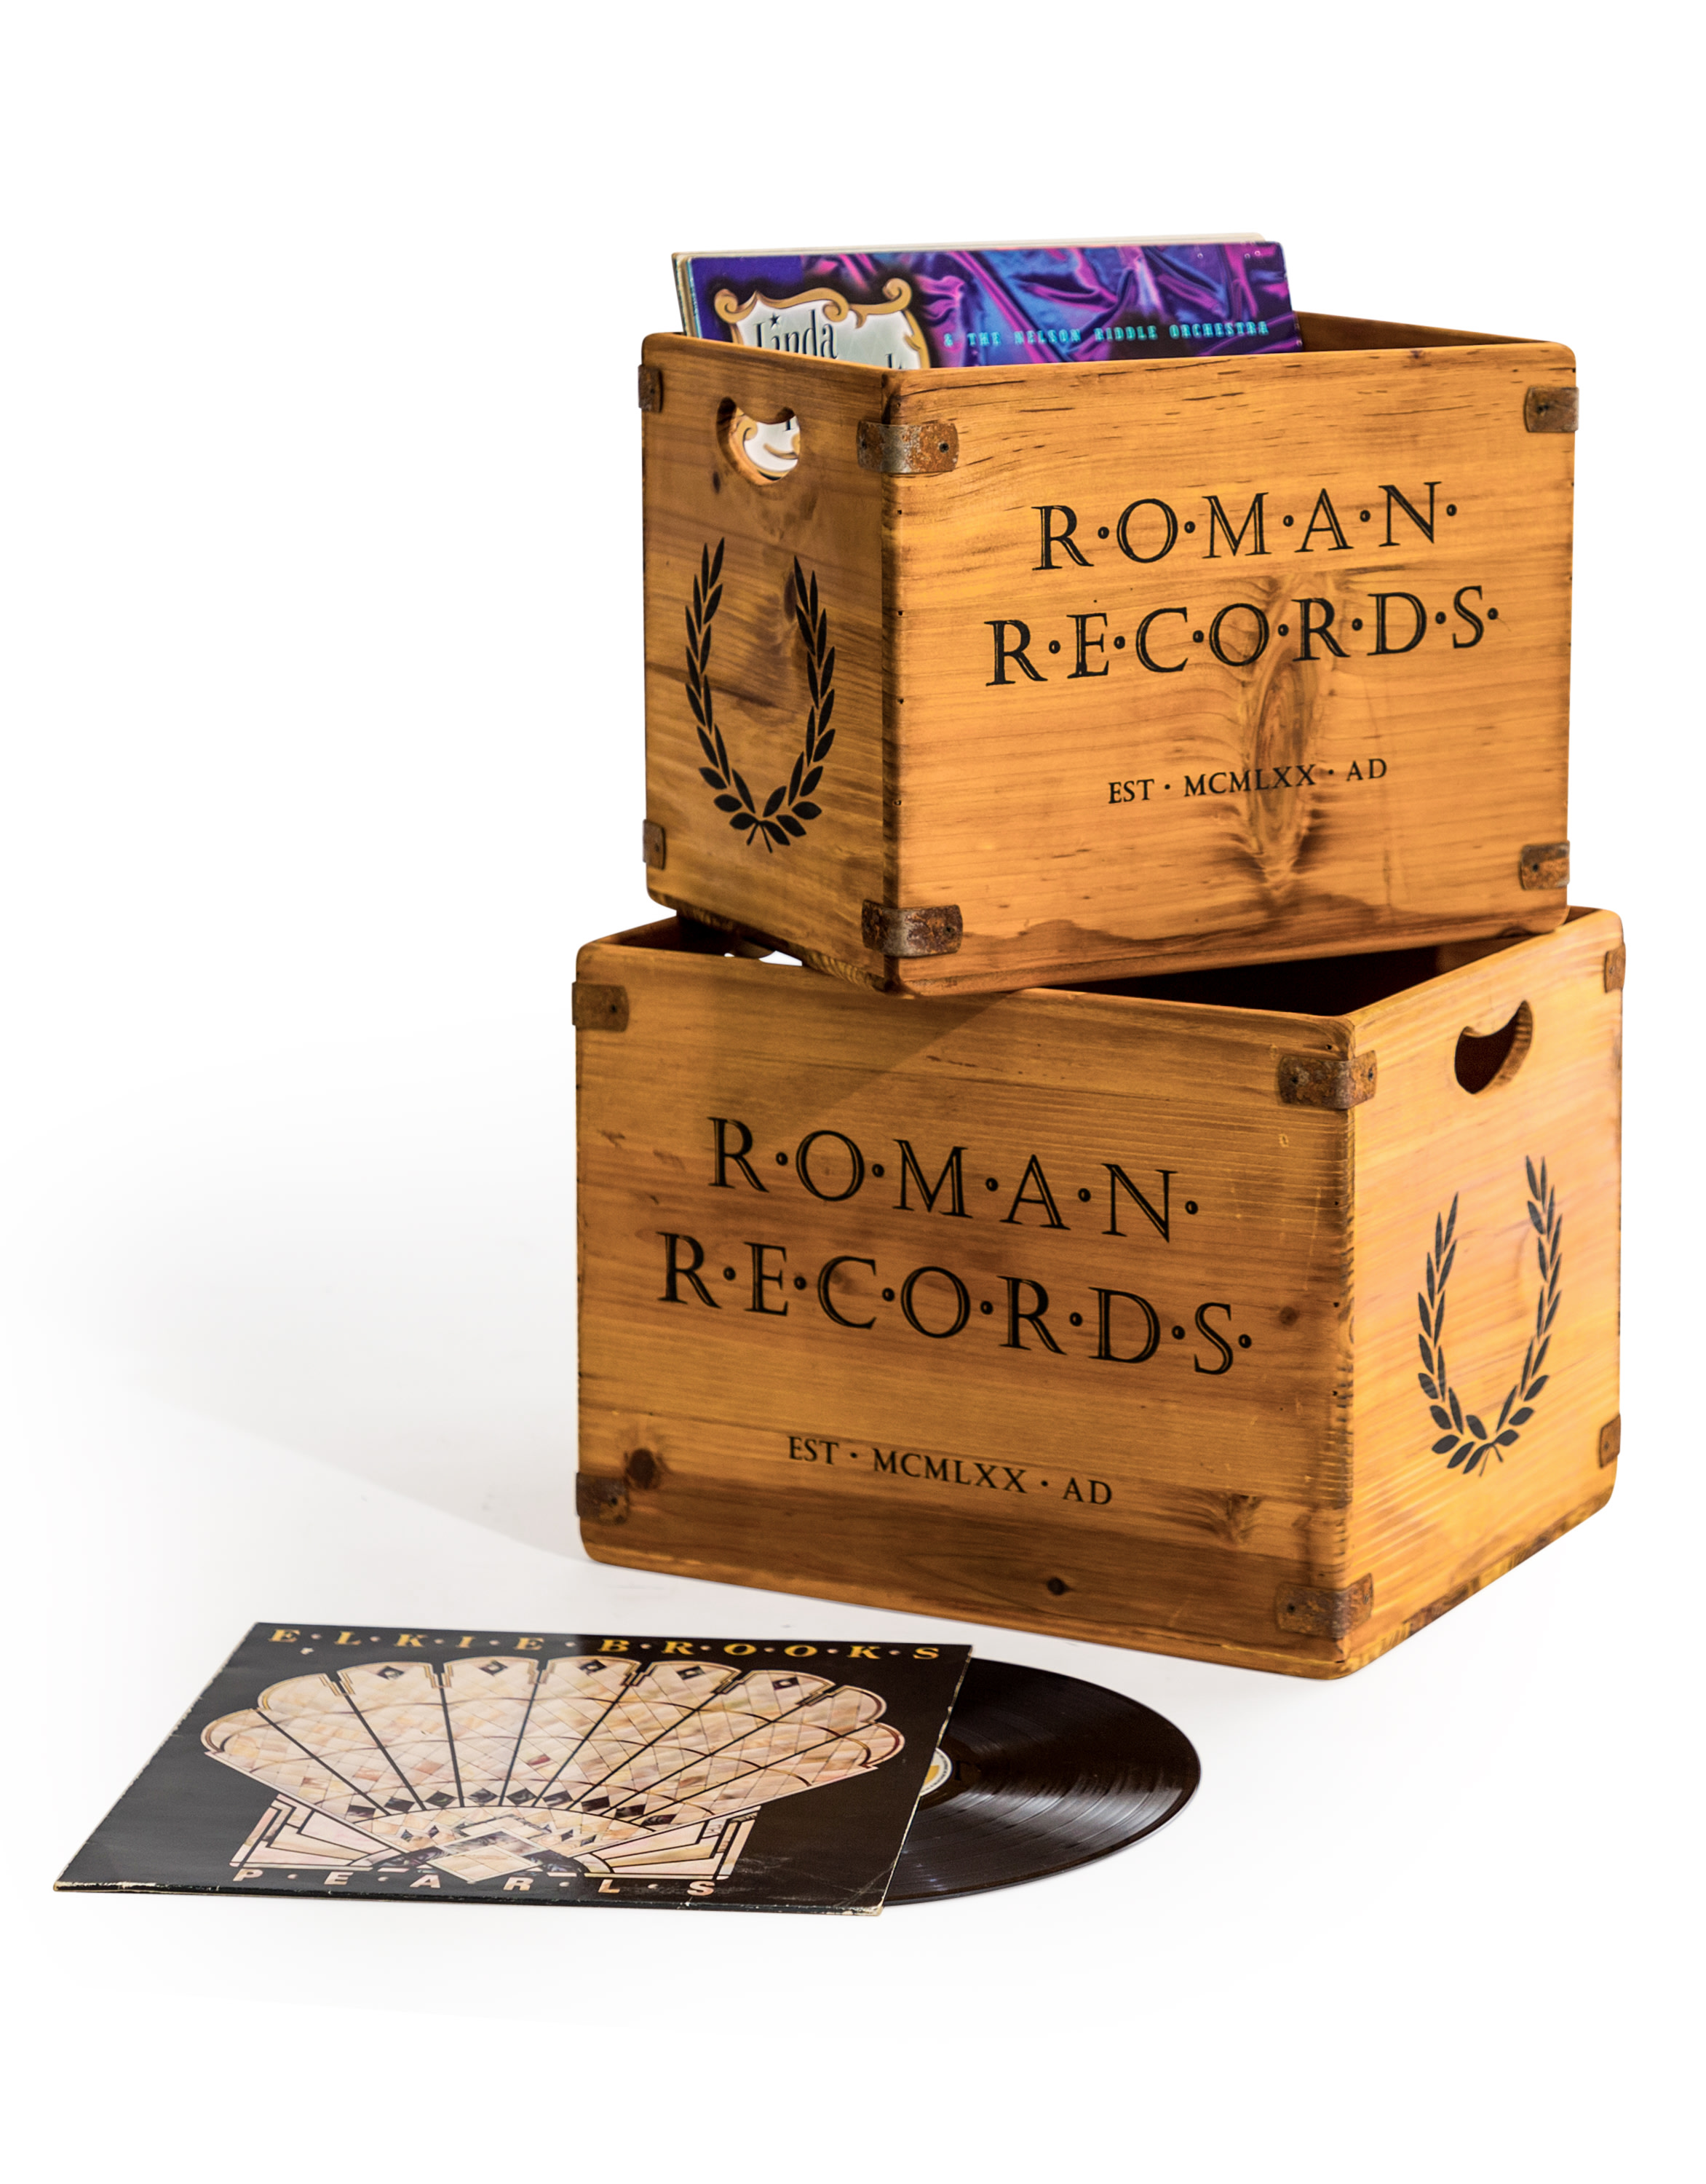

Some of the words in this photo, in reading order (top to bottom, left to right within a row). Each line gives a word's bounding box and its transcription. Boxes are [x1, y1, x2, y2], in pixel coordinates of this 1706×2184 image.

[967, 331, 1001, 346] THE
[1015, 328, 1082, 344] NELSON
[1094, 325, 1158, 342] RIDDLE
[1169, 320, 1269, 339] ORCHESTRA
[1107, 778, 1155, 804] EST
[1183, 762, 1317, 798] MCMLXX
[1346, 758, 1388, 782] AD
[787, 1436, 839, 1465] EST
[873, 1447, 1028, 1495] MCMLXX
[1062, 1476, 1114, 1506] AD
